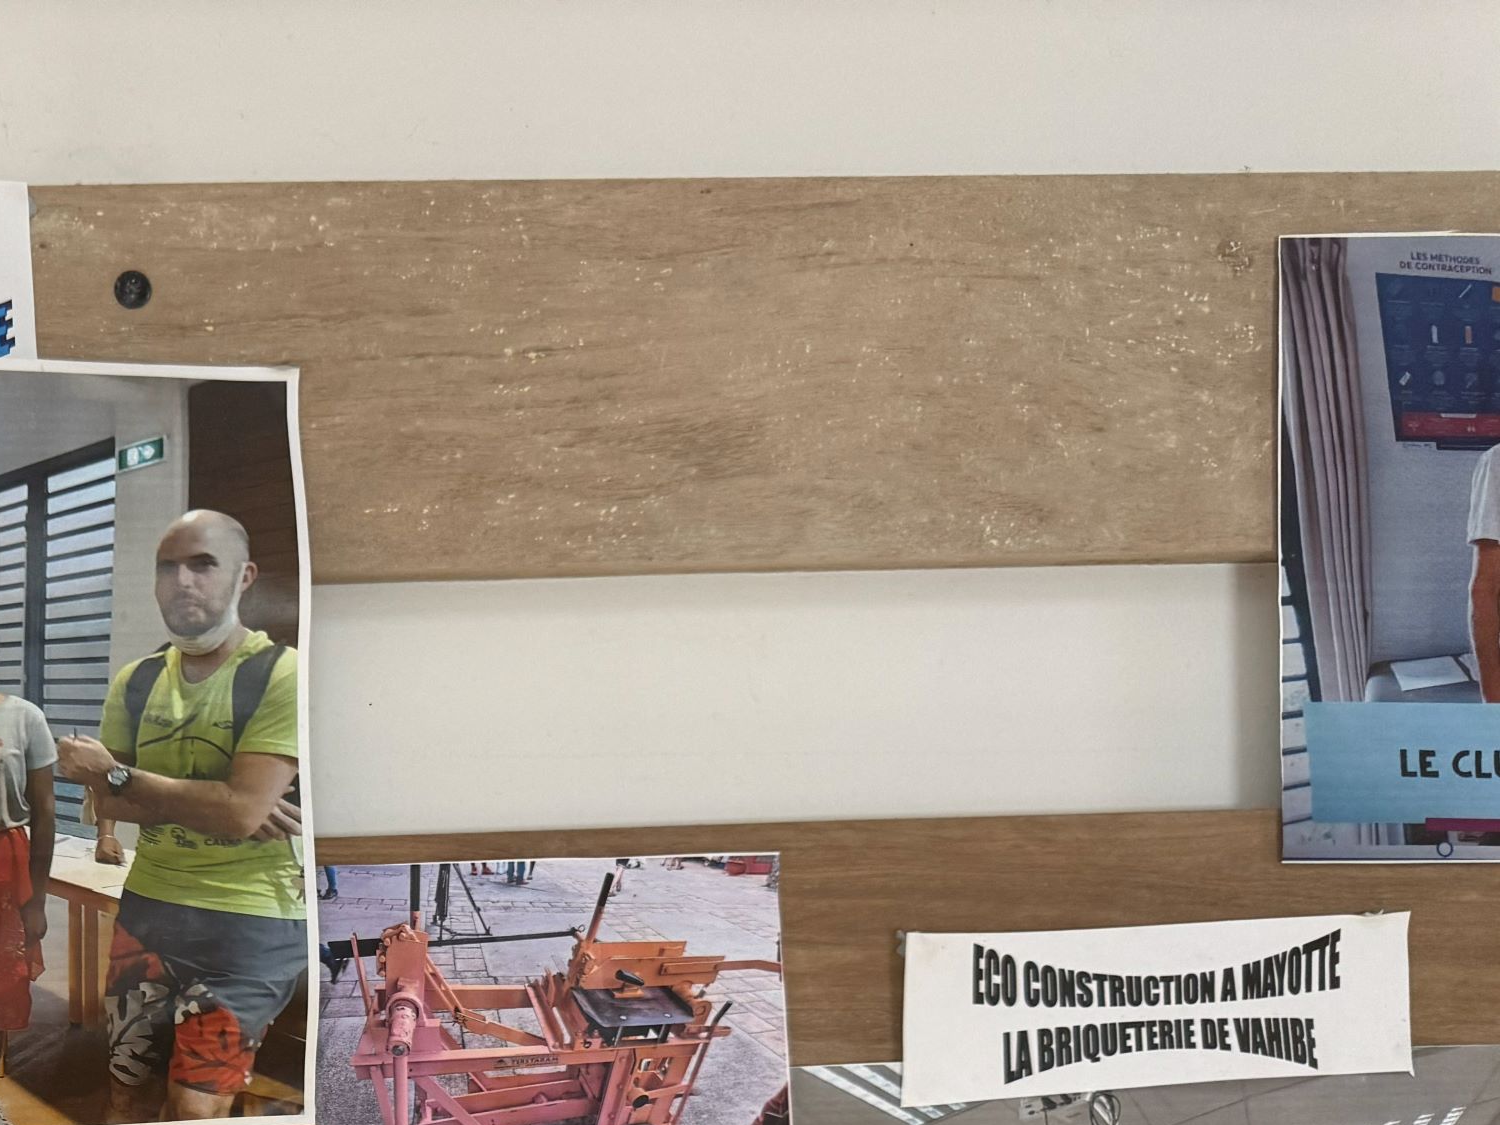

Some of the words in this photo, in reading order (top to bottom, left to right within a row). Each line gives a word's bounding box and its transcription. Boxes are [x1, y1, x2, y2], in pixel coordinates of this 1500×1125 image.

[1399, 749, 1439, 778] LE
[972, 943, 1018, 1007] ECO
[1023, 961, 1216, 1008] CONSTRUCTION
[1220, 966, 1237, 1003] A
[1241, 928, 1342, 1001] MAYOTTE
[1002, 1030, 1033, 1085] LA
[1036, 1018, 1197, 1073] BRIQUETERIE
[1200, 1017, 1232, 1051] DE
[1232, 1017, 1319, 1070] VAHIBE
